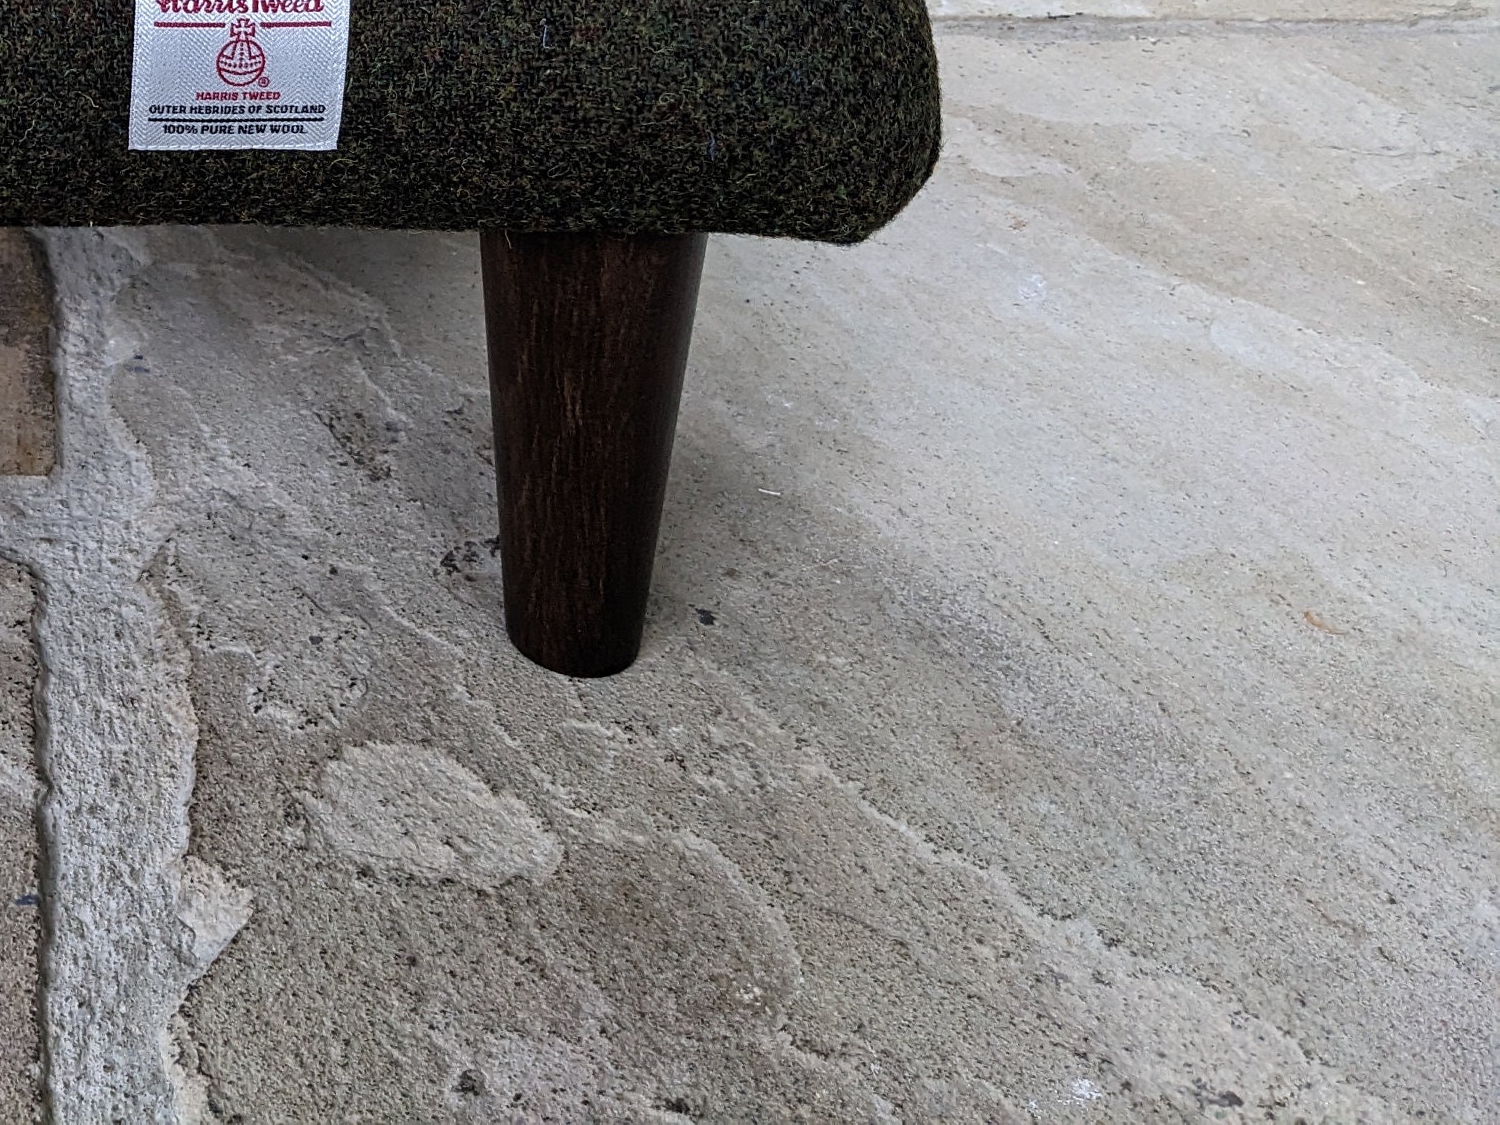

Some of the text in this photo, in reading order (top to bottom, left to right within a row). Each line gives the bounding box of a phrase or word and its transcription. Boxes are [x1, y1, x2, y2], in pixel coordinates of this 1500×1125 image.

[195, 91, 281, 101] HARRIS TWEED
[149, 104, 326, 115] OUTER HEBRIDES OF SCOTLAND
[162, 124, 308, 135] 100% PURE NEW WOOL
